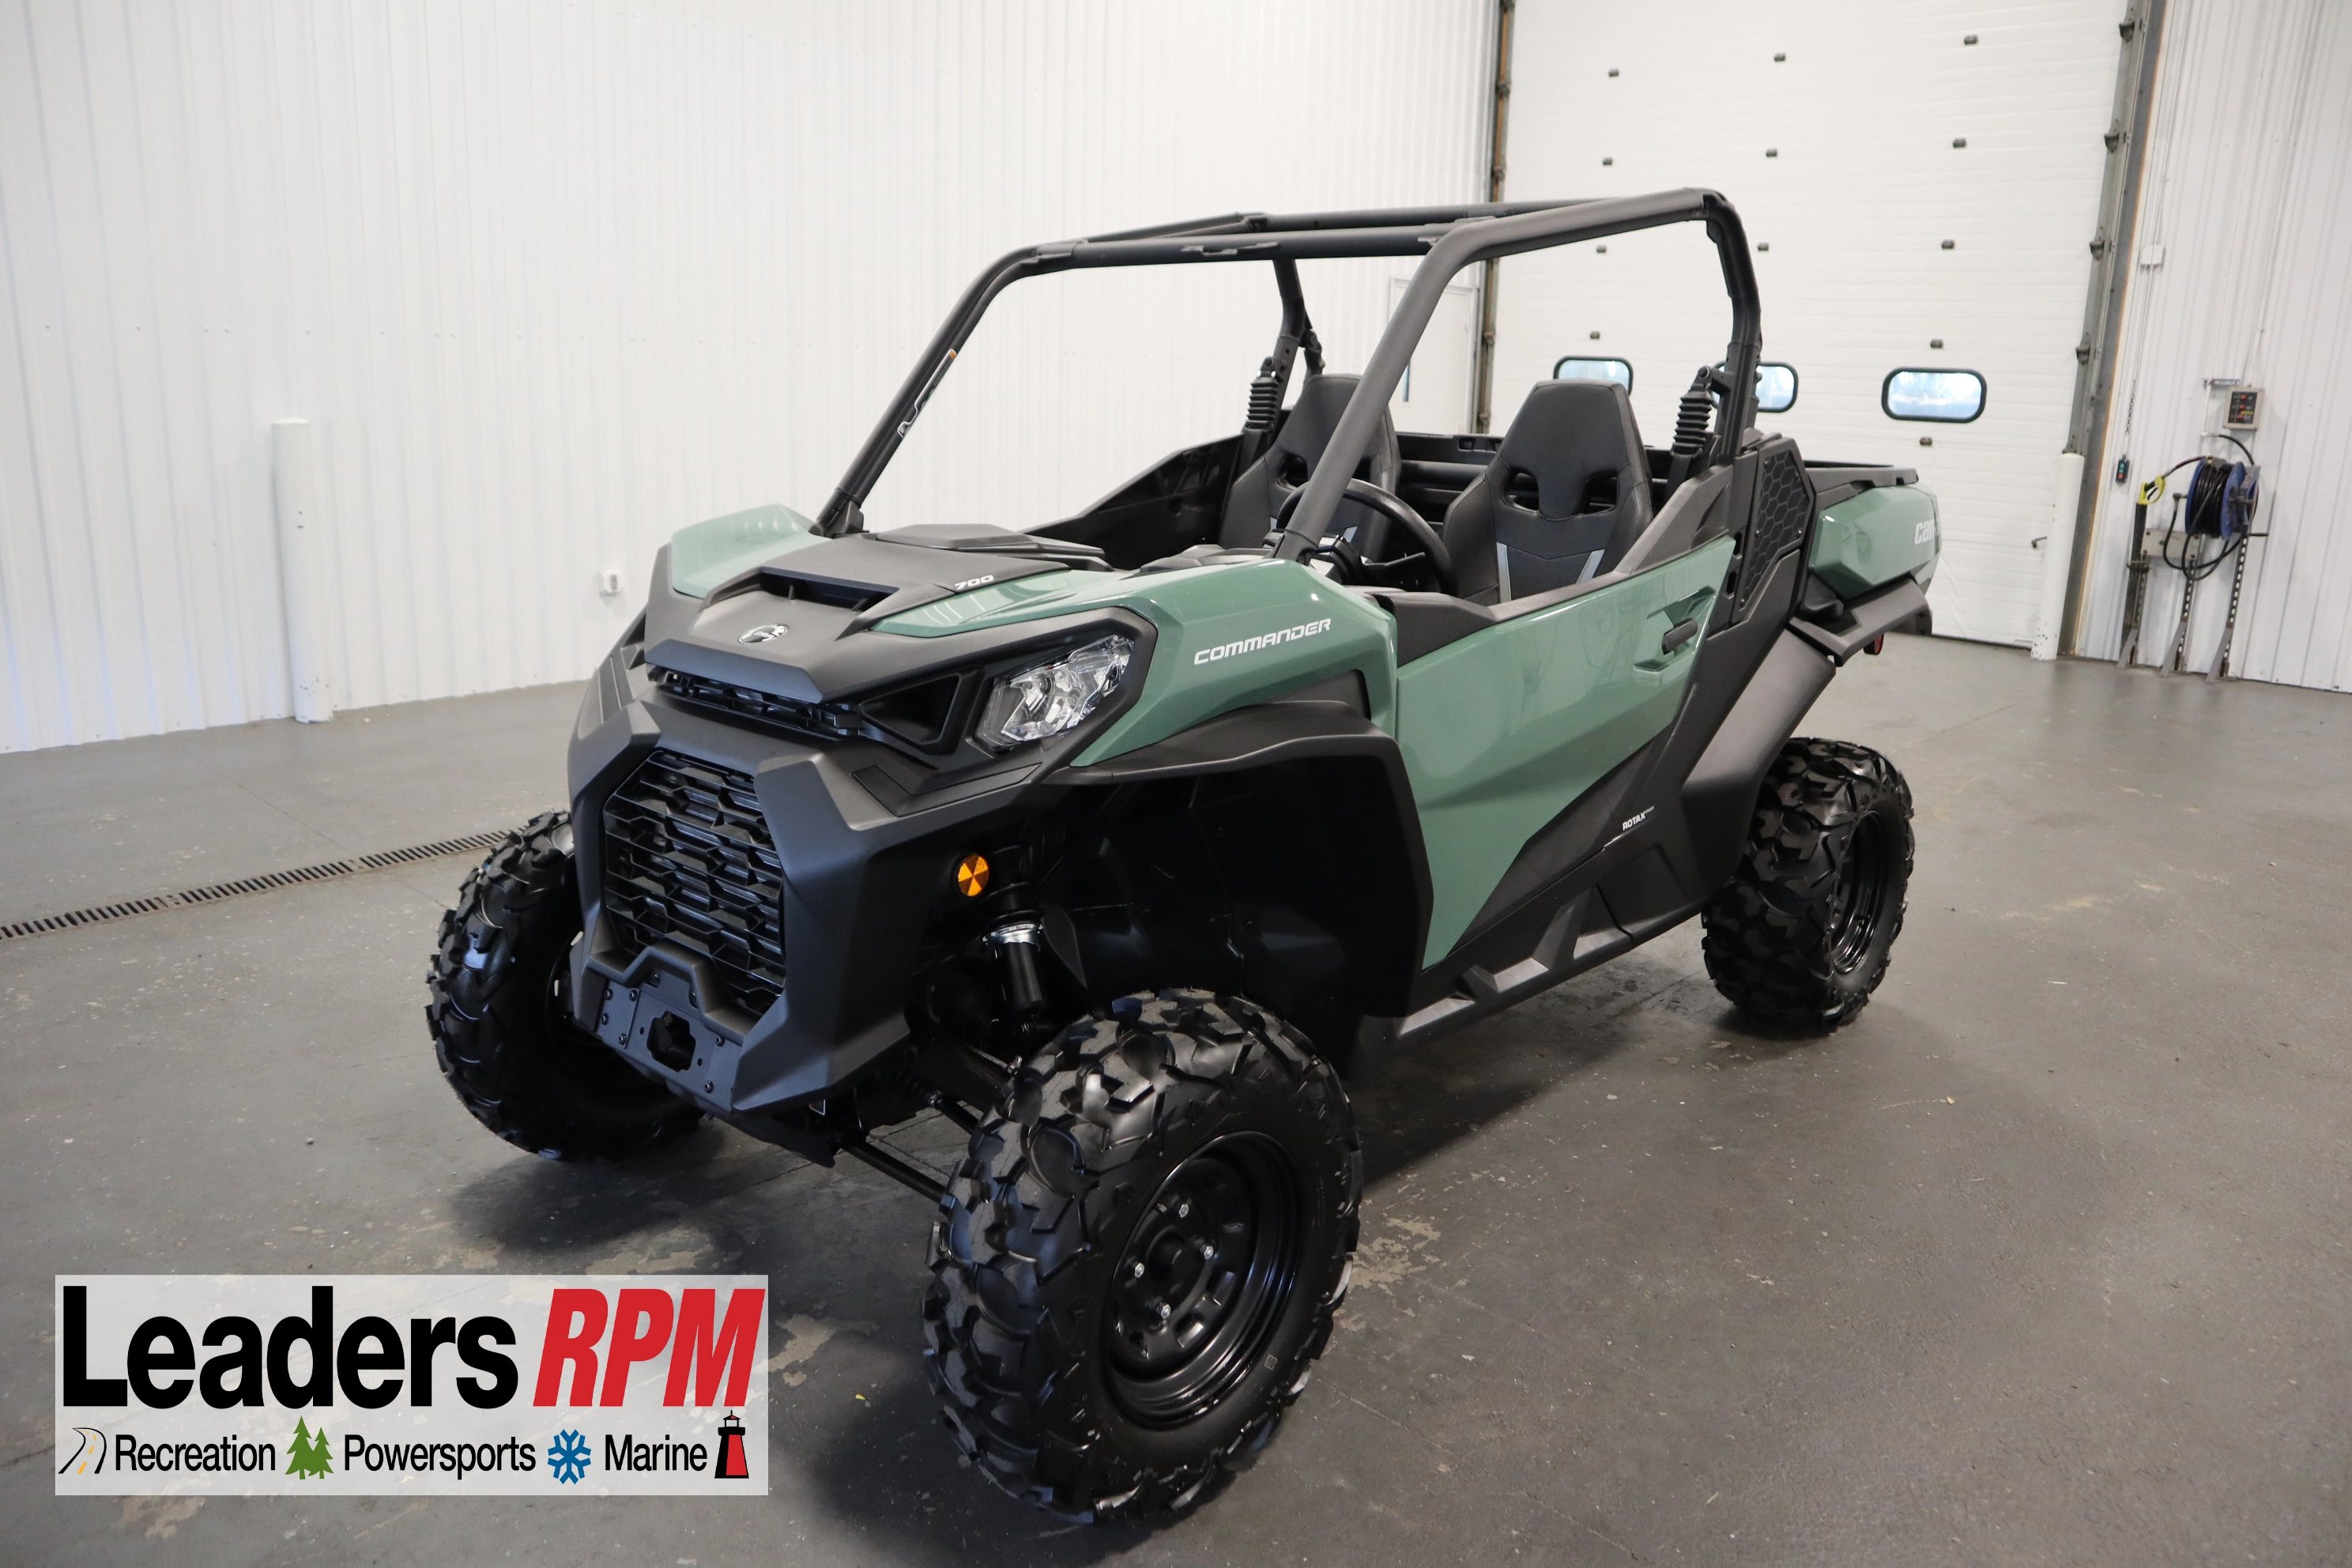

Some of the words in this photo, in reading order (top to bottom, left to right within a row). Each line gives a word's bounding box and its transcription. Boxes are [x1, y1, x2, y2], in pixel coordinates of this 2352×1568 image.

[954, 575, 994, 590] 700
[1193, 618, 1332, 665] COMMANDER
[1622, 811, 1646, 831] ROTAX
